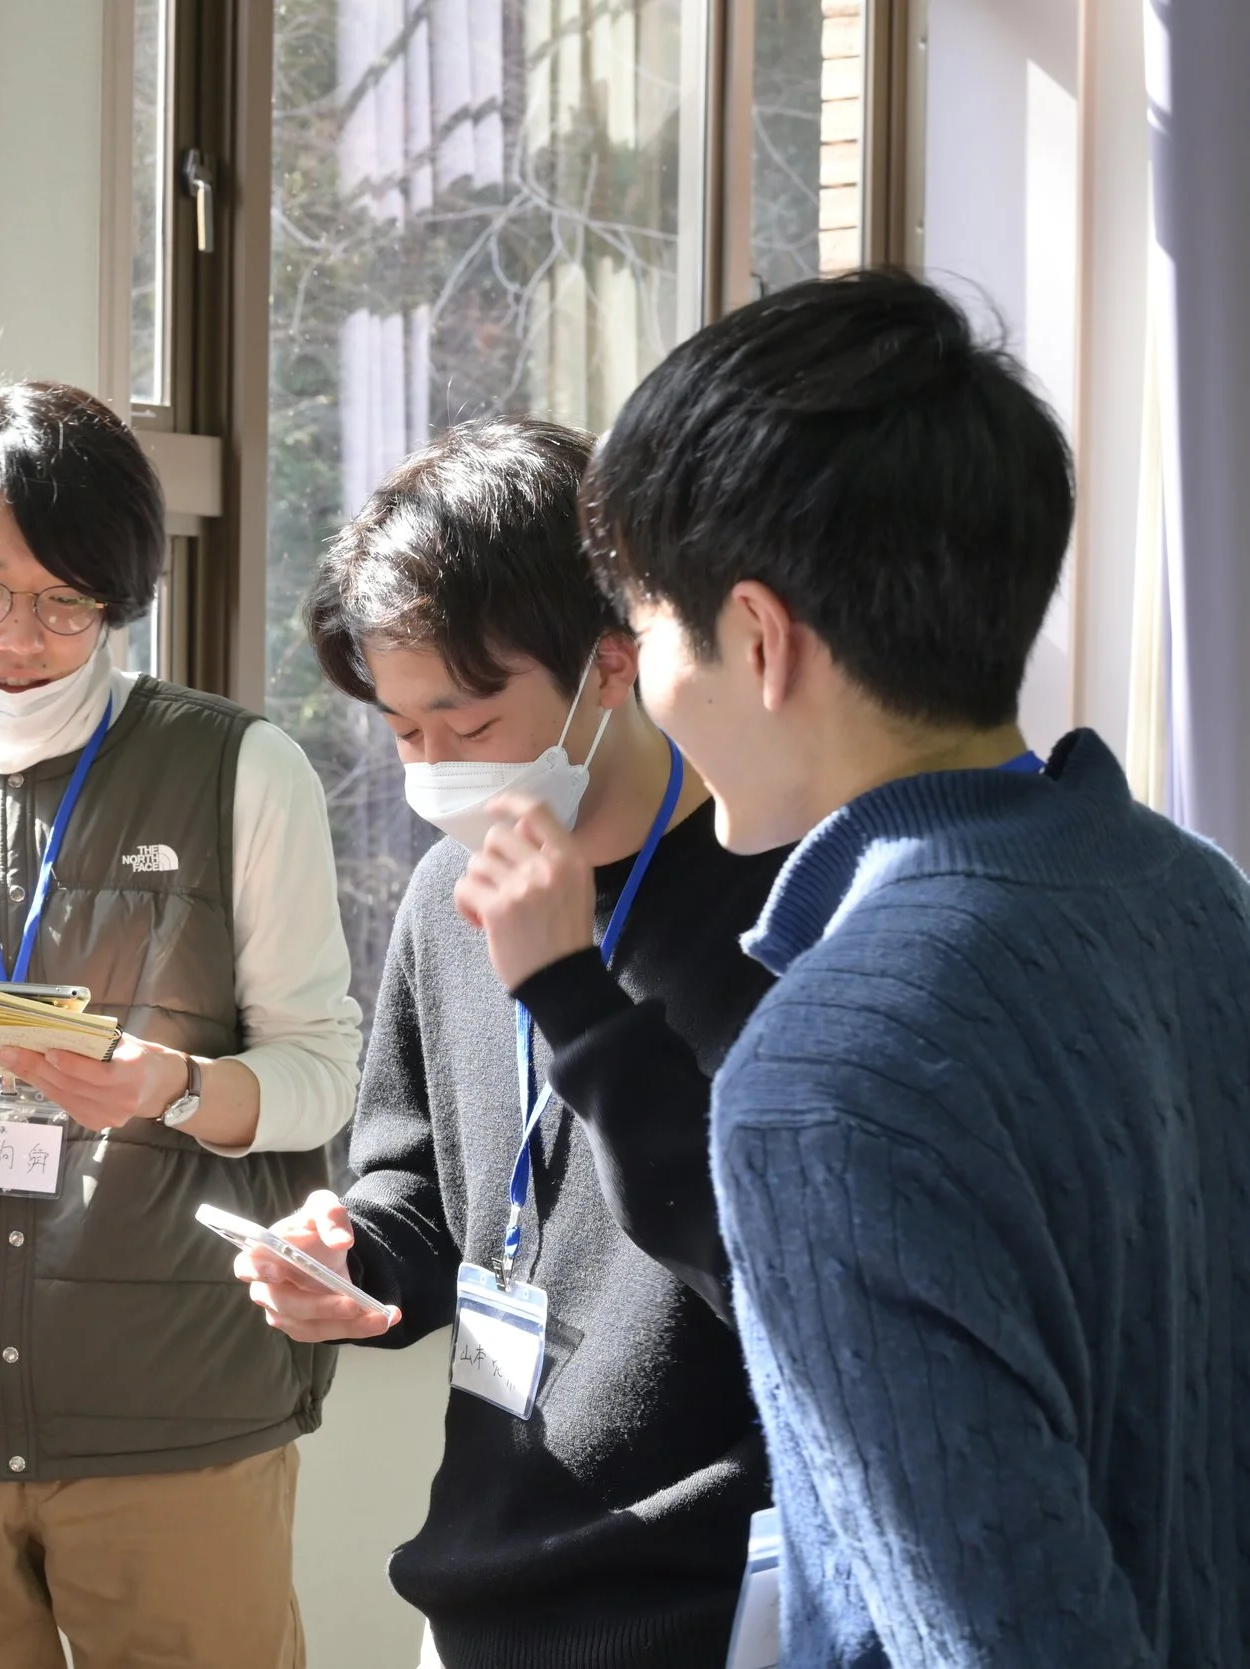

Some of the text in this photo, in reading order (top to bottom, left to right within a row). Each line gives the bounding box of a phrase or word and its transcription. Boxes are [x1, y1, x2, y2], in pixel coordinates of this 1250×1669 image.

[137, 844, 159, 855] THE
[122, 853, 159, 865] NORTH
[132, 863, 160, 873] FACE
[460, 1343, 487, 1370] 山本
